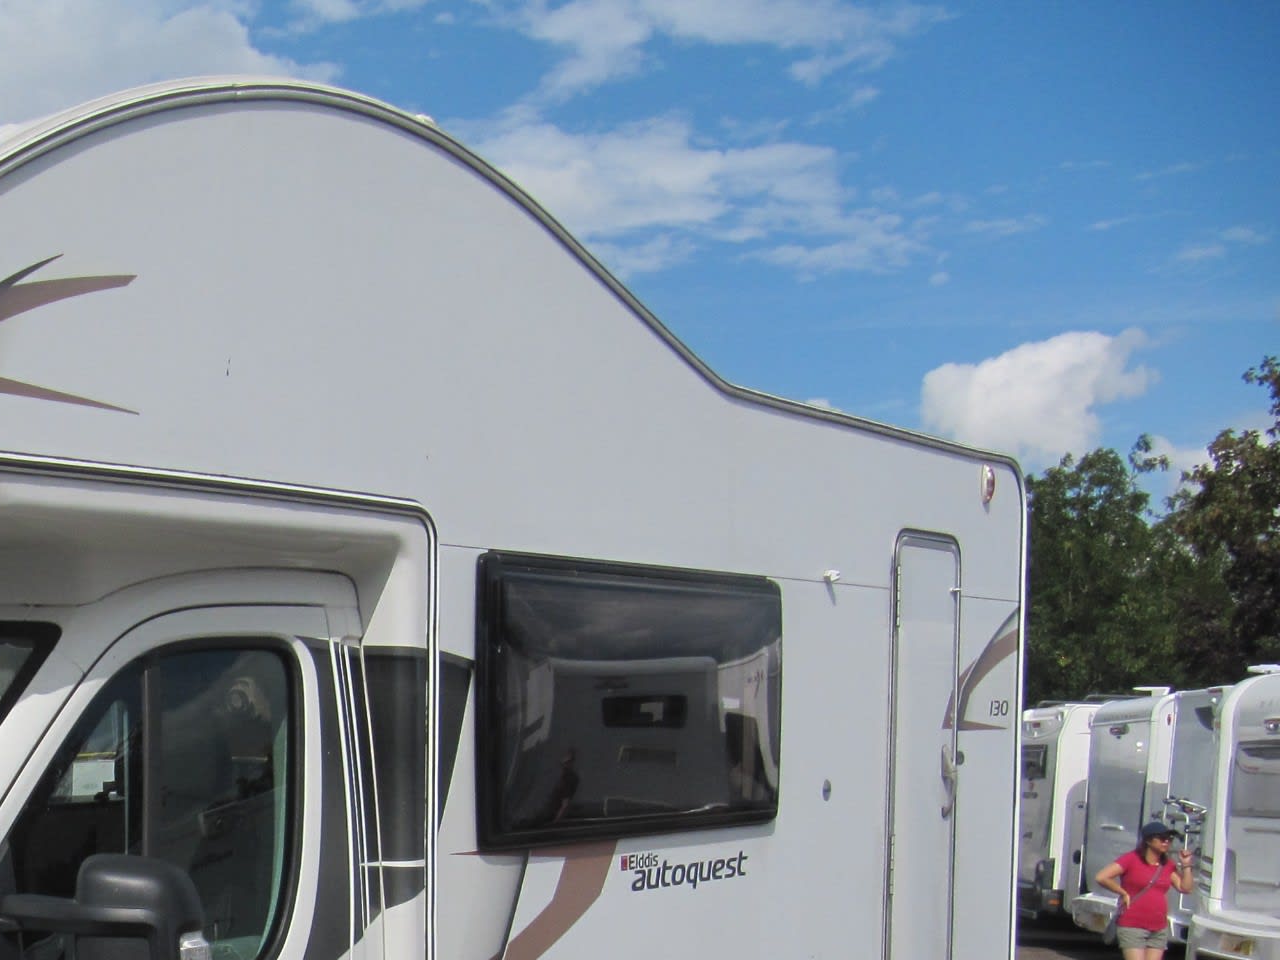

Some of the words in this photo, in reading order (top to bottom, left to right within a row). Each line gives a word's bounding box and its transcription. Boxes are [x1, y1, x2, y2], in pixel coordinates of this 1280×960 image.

[990, 700, 1009, 717] 130
[627, 853, 659, 870] Elddis
[631, 850, 748, 892] autoquest
